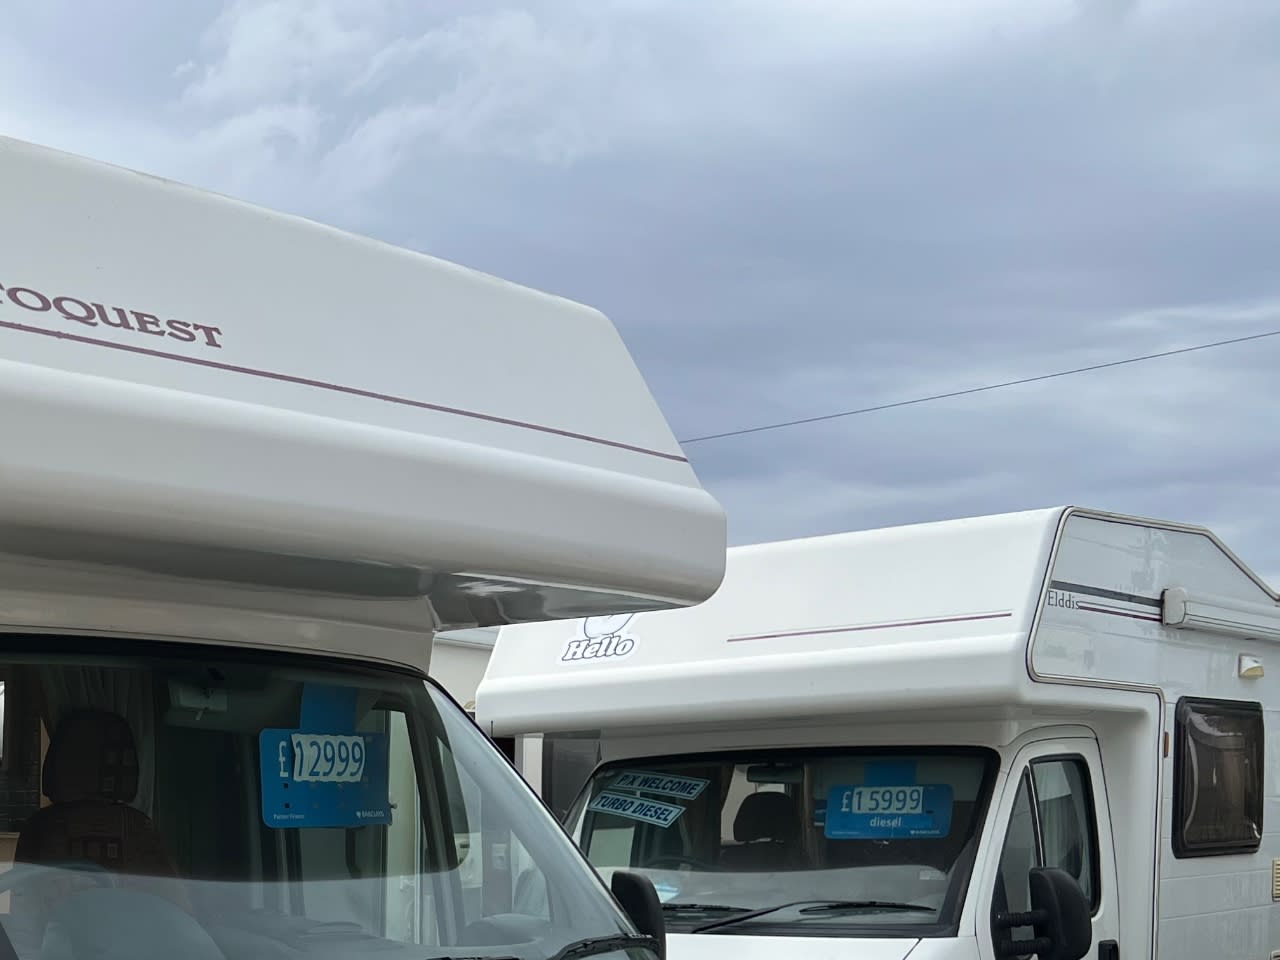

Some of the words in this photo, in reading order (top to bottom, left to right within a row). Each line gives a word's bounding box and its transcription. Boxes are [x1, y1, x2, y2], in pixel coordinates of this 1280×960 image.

[1047, 590, 1080, 610] Elddis
[561, 635, 635, 661] Hello
[638, 776, 701, 796] WELCOME
[595, 795, 635, 812] TURBO
[632, 802, 674, 822] DIESEL
[869, 816, 902, 828] diesel
